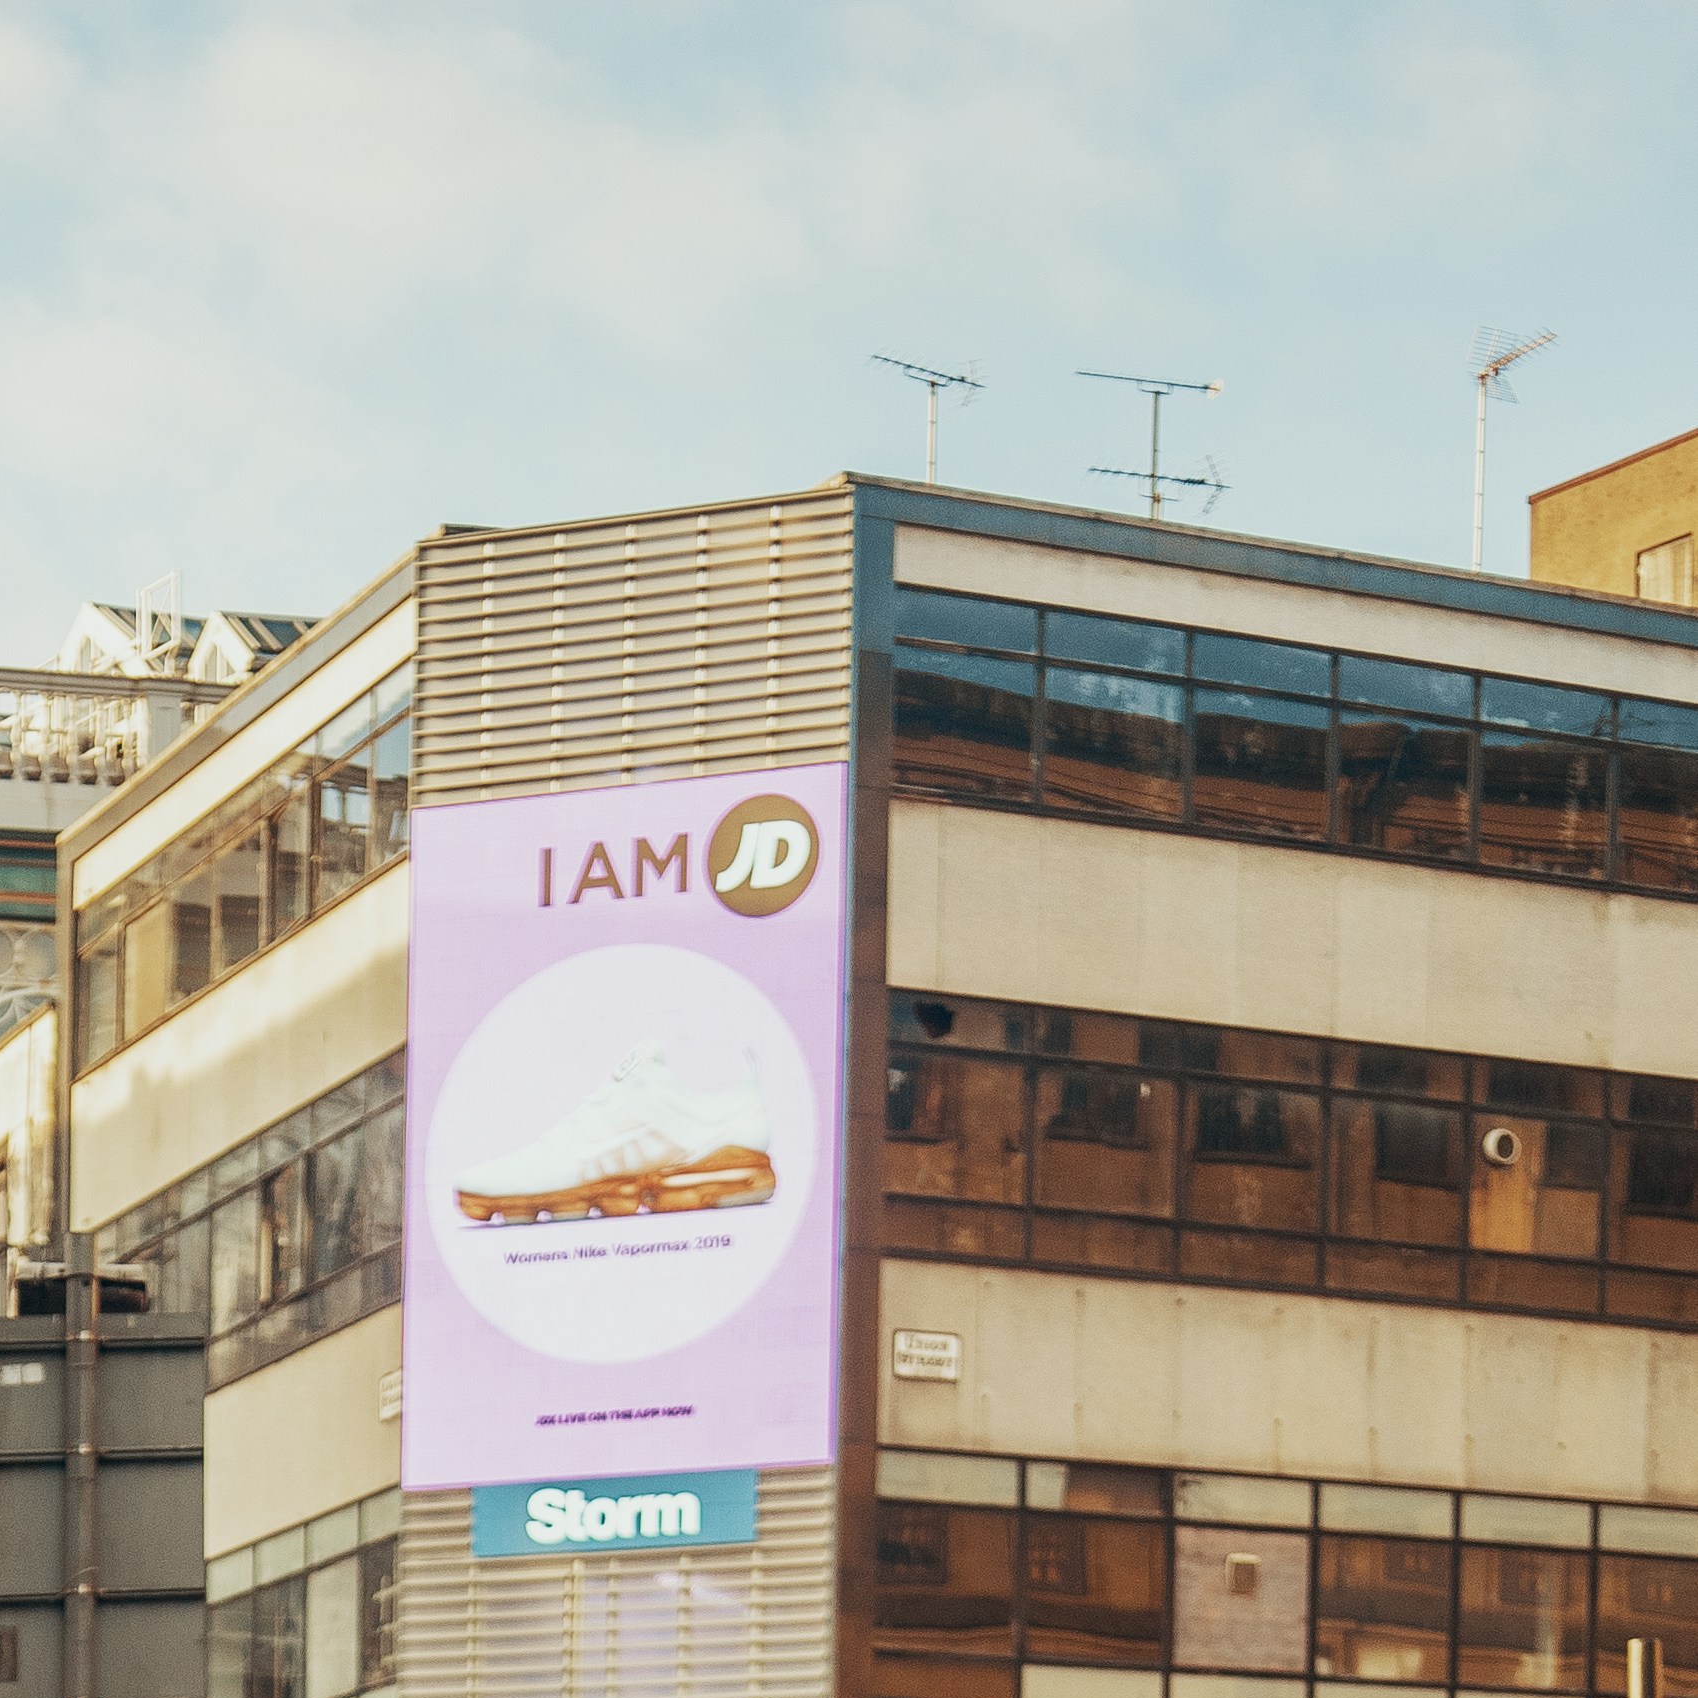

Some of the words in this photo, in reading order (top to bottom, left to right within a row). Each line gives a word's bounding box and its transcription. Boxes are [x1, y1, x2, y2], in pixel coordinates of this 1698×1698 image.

[538, 846, 553, 910] I
[568, 831, 692, 907] AM
[715, 818, 810, 894] JD
[504, 1248, 569, 1266] Womens
[573, 1244, 606, 1260] Nike
[611, 1238, 689, 1258] Vapormax
[693, 1234, 732, 1251] 2019
[609, 1408, 633, 1421] THE
[634, 1406, 660, 1419] APP
[524, 1486, 702, 1544] Storm
